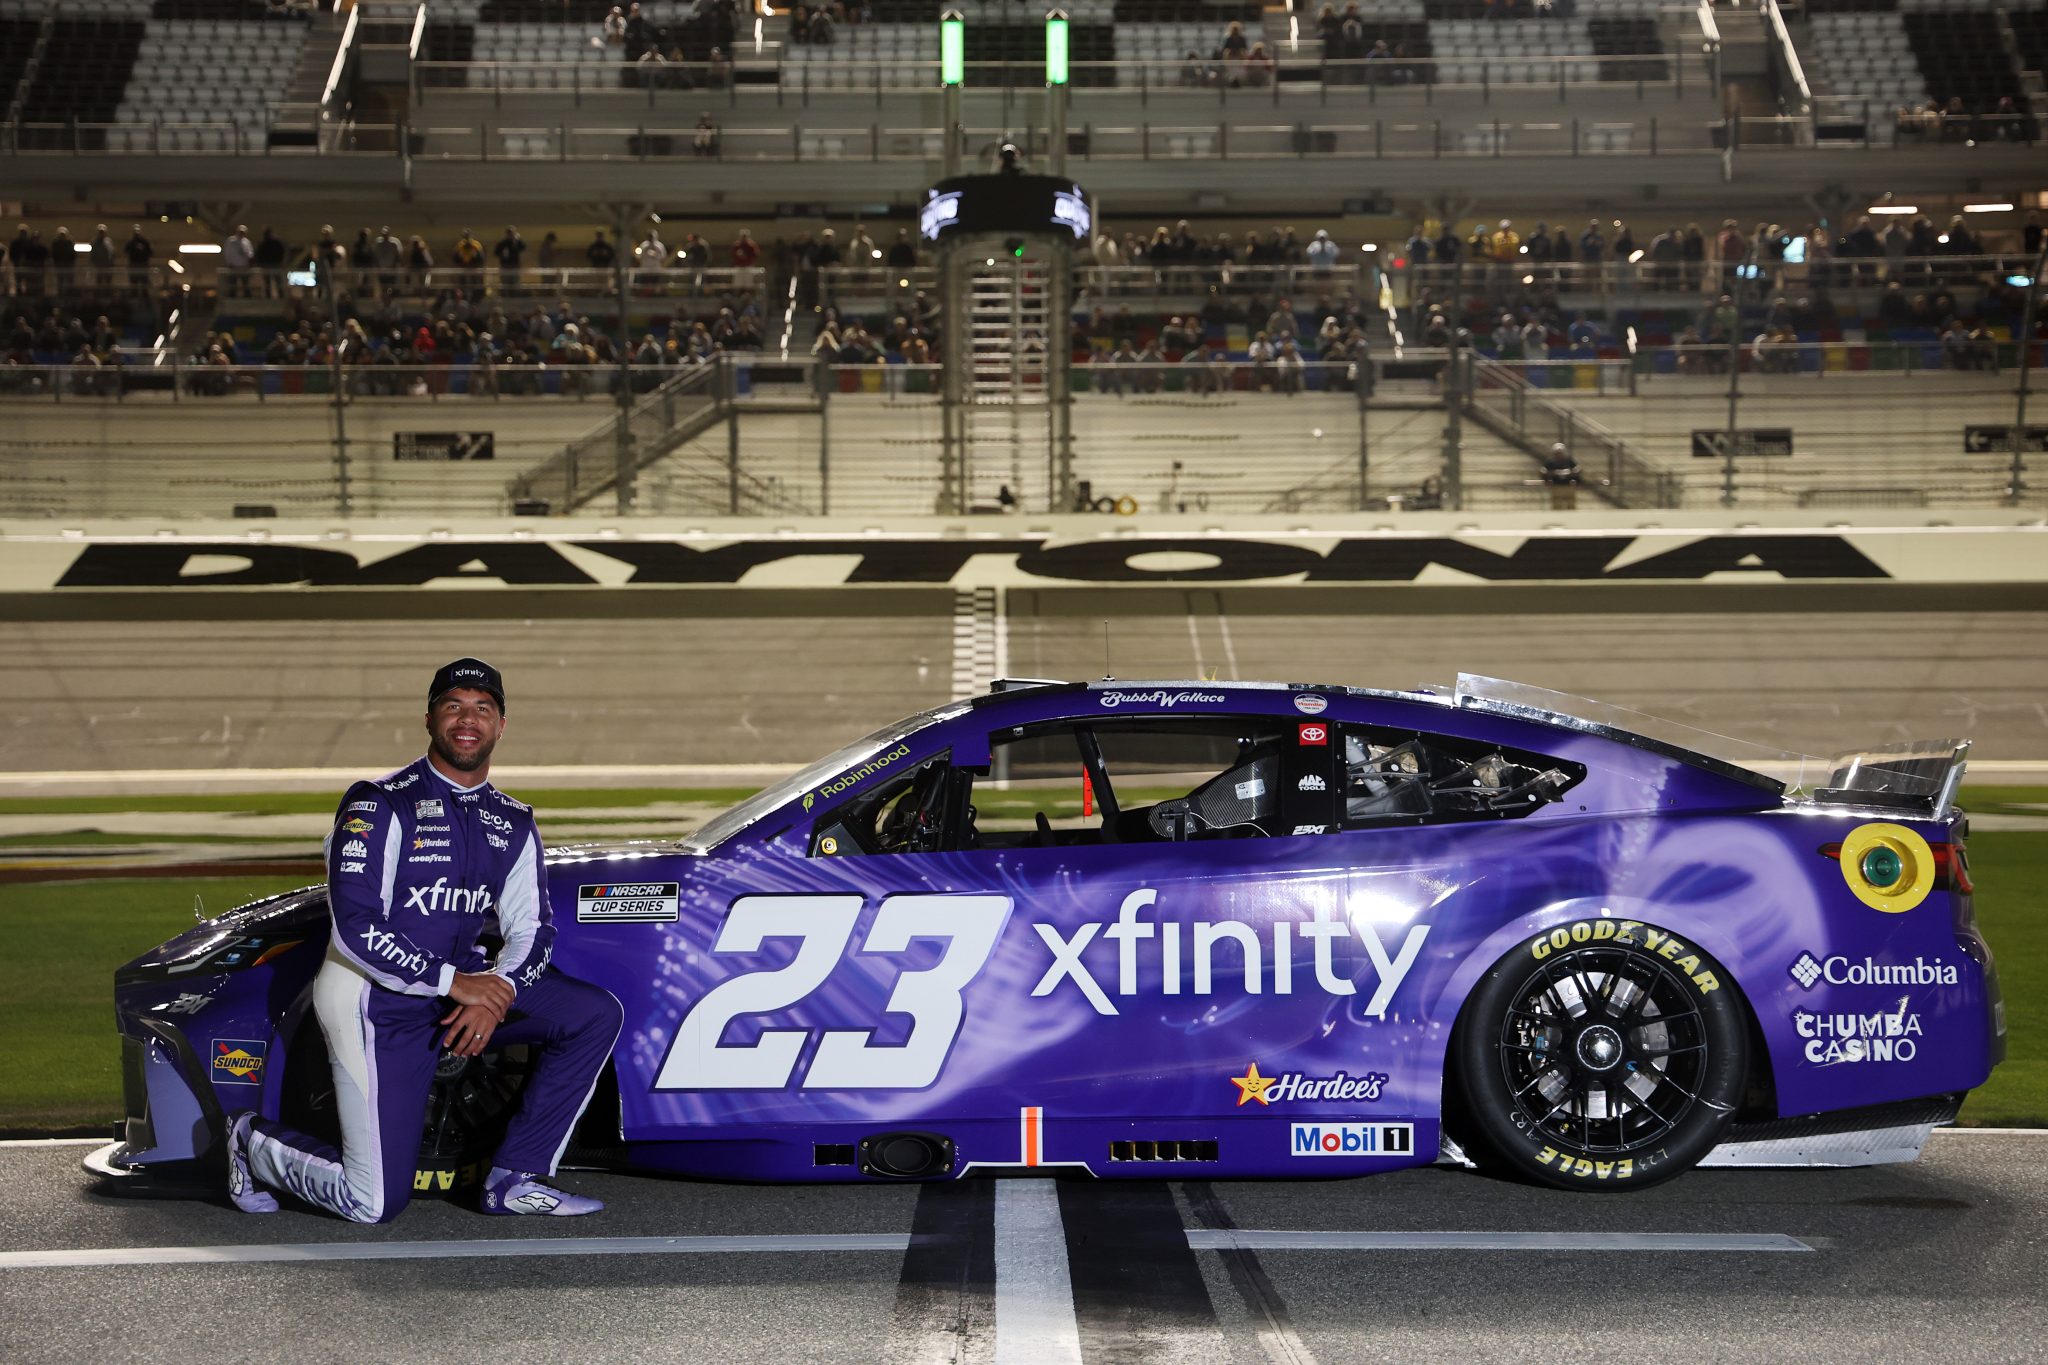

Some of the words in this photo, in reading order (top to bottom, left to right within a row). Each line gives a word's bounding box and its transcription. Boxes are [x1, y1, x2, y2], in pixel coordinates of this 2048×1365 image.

[53, 536, 1894, 588] DAYTONA
[455, 667, 485, 678] xfinity
[1099, 690, 1158, 708] Bubba
[1154, 690, 1226, 708] Wallace
[820, 743, 911, 799] Robinhood
[1298, 774, 1326, 787] MAC
[343, 821, 374, 831] SUNOCO
[404, 877, 493, 916] xfinity
[611, 885, 664, 896] NASCAR
[592, 901, 618, 912] CUP
[618, 900, 665, 912] SERIES
[359, 923, 430, 977] xfinity
[1030, 888, 1431, 1016] xfinity
[1823, 956, 1958, 985] Columbia
[654, 895, 1013, 1089] 23
[1795, 1012, 1922, 1038] CHUMBA
[216, 1057, 261, 1069] SUNOCO
[1804, 1038, 1917, 1063] CASINO
[1265, 1073, 1382, 1102] Hardee's
[1295, 1127, 1376, 1152] Mobil
[1534, 1145, 1633, 1179] EAGLE
